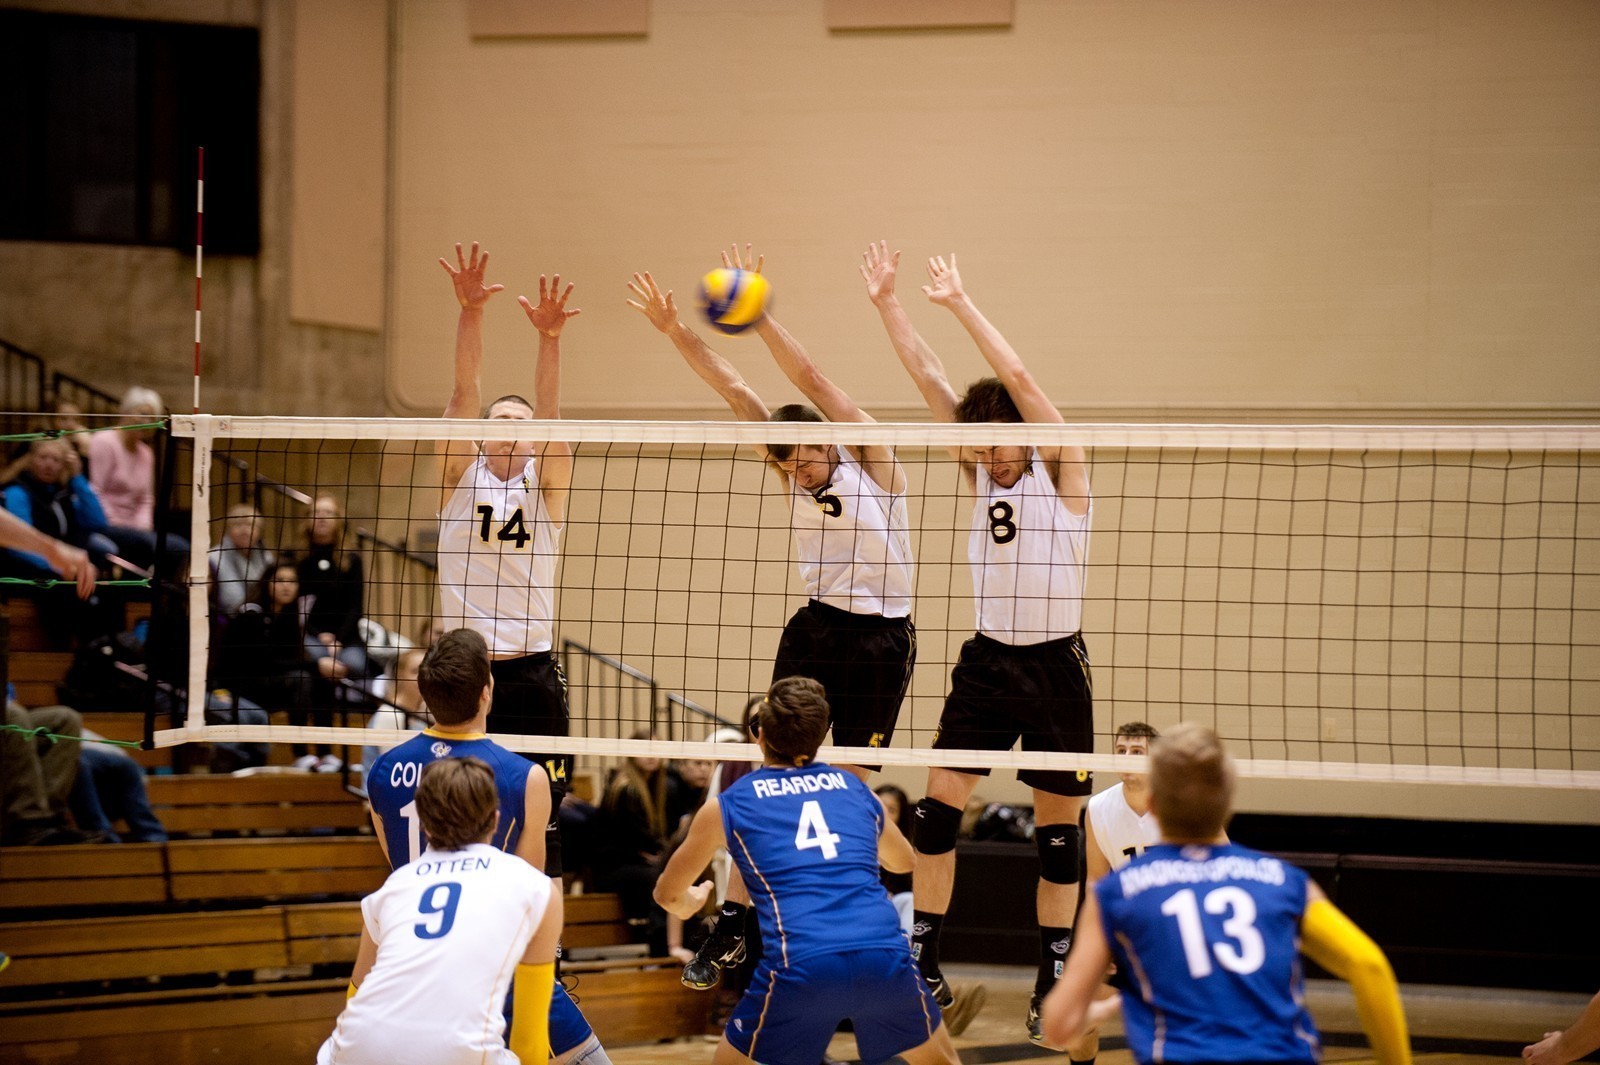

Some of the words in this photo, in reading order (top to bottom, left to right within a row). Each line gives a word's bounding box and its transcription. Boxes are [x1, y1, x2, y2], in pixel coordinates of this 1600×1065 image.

[476, 503, 532, 550] 14
[988, 500, 1017, 545] 8
[752, 772, 849, 799] REARDON
[795, 800, 841, 861] 4
[416, 857, 491, 876] OTTEN
[414, 881, 463, 940] 9
[1160, 885, 1266, 980] 13
